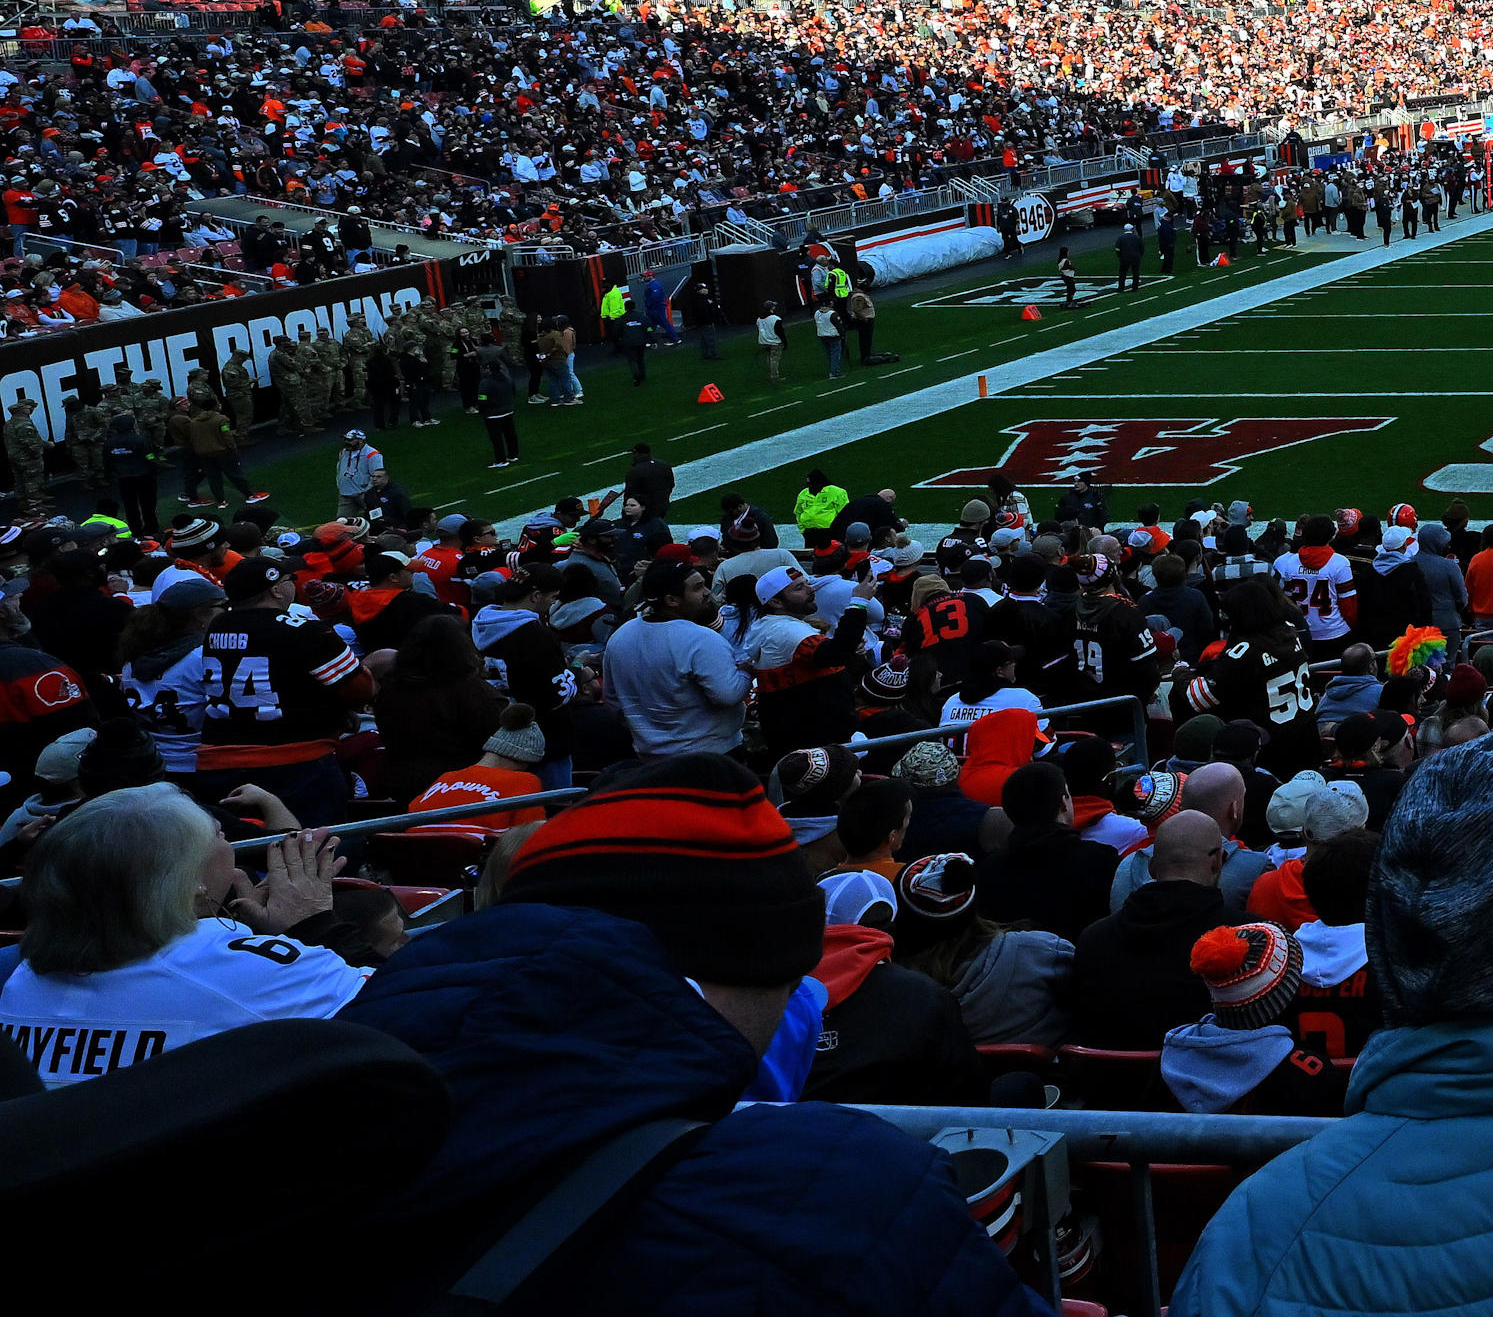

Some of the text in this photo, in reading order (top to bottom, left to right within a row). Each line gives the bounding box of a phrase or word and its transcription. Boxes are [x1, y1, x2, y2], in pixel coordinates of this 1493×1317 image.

[1018, 204, 1044, 235] 946
[322, 236, 335, 252] 9
[0, 332, 200, 444] OF THE
[916, 599, 969, 649] 13
[209, 632, 249, 651] CHUBB
[1073, 639, 1104, 684] 19
[420, 780, 501, 804] Browns
[227, 935, 301, 965] 6
